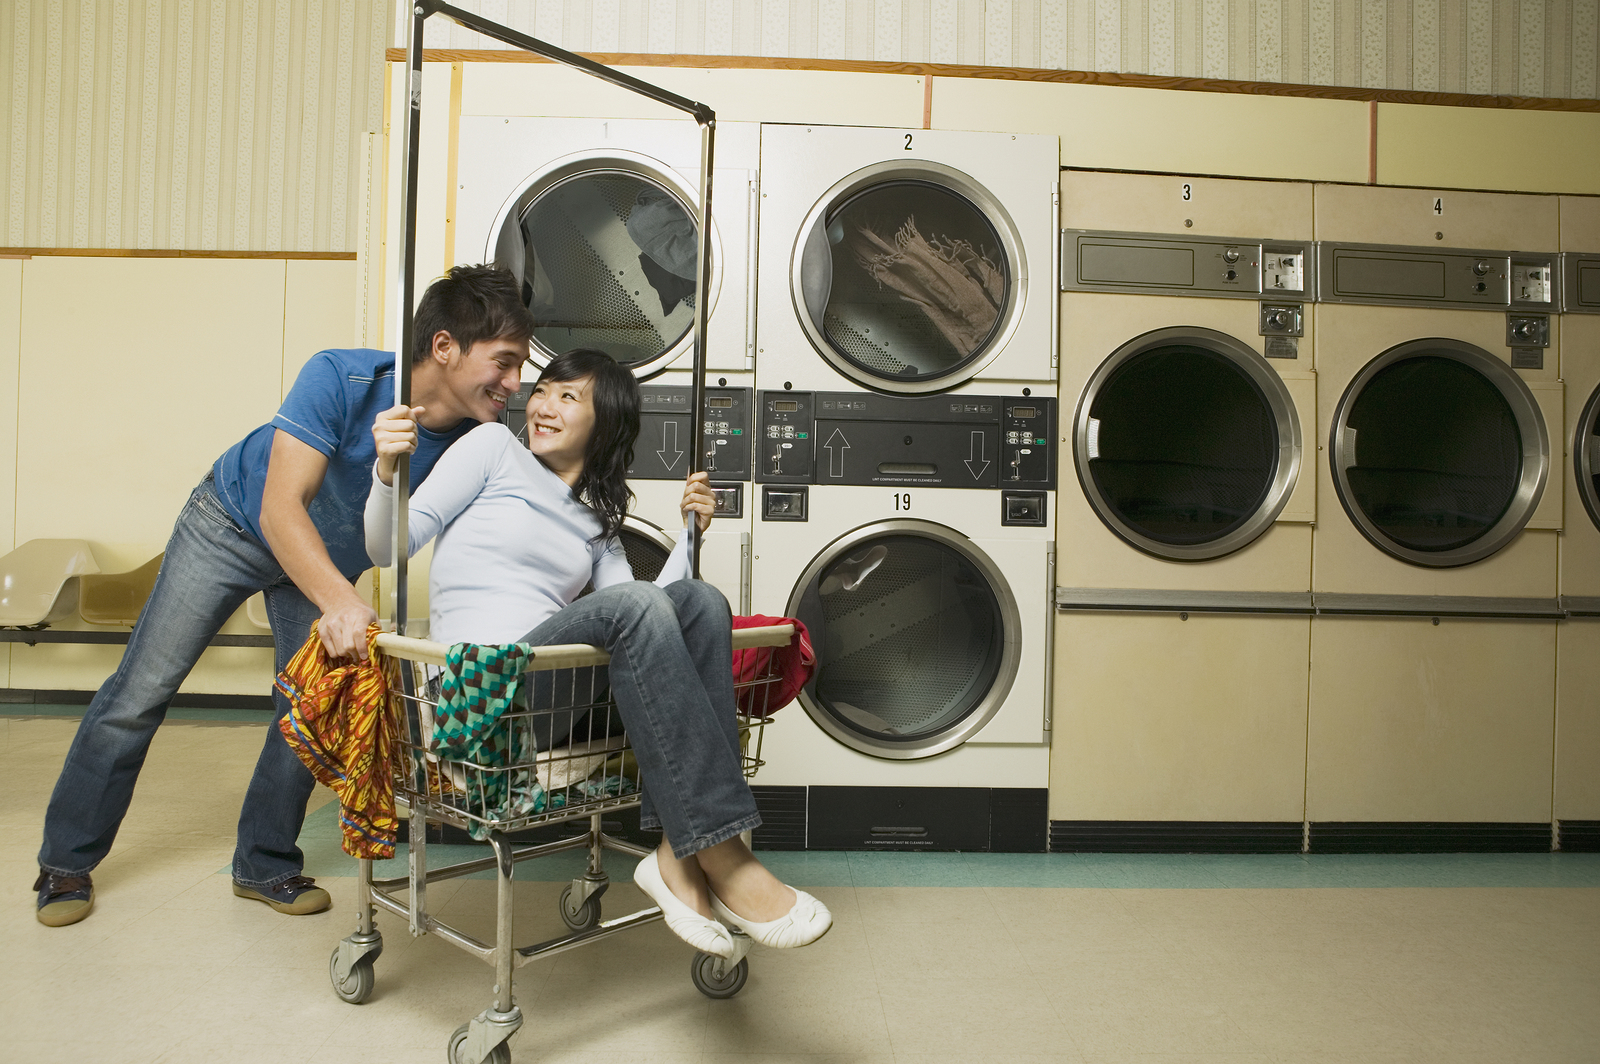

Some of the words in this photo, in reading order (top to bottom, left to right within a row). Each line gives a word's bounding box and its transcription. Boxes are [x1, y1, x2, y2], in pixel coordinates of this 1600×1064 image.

[603, 121, 608, 139] 1
[904, 133, 913, 151] 2
[1183, 184, 1191, 201] 3
[1434, 198, 1442, 215] 4
[893, 493, 911, 511] 19
